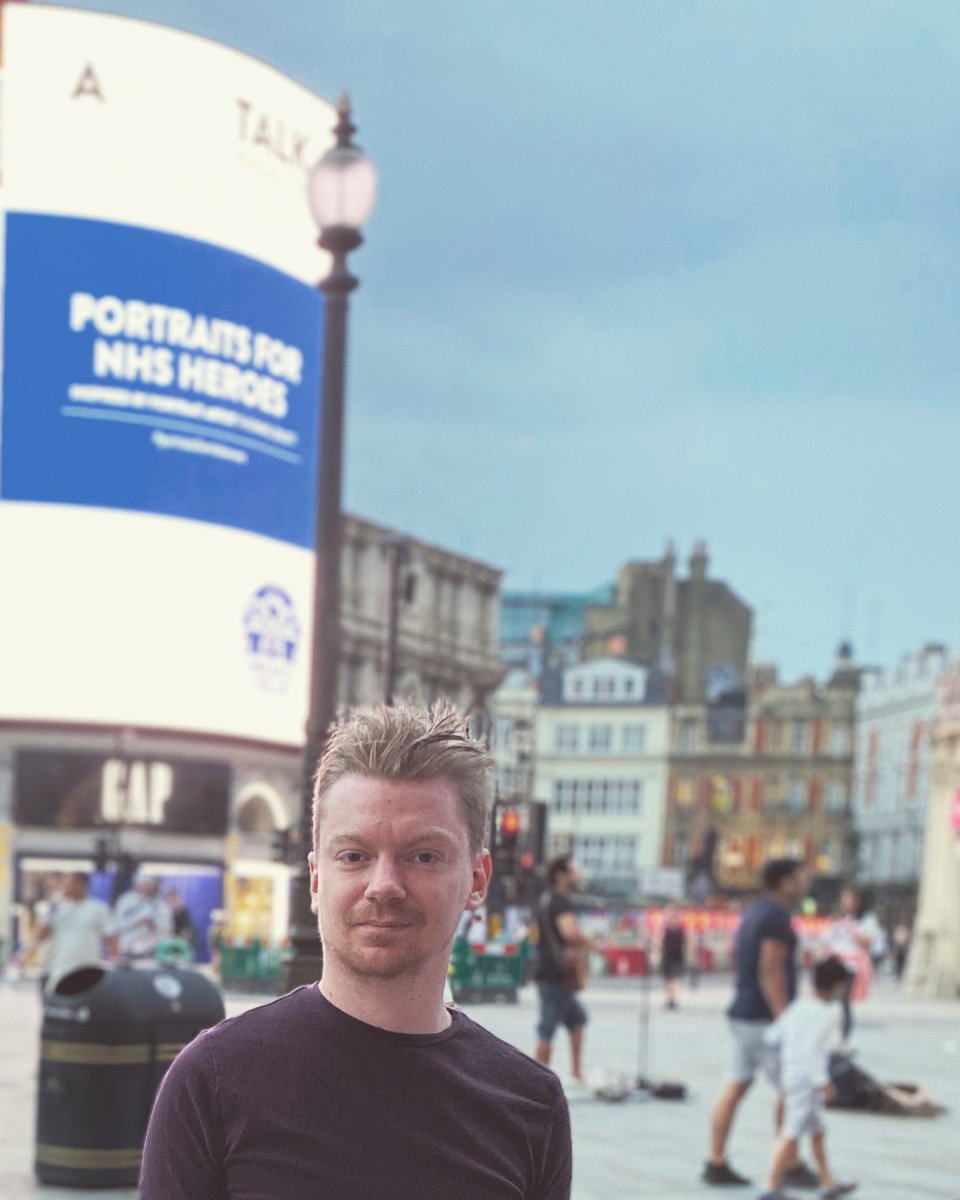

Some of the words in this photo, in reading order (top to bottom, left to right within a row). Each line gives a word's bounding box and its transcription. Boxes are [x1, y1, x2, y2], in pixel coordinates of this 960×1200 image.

[69, 291, 252, 364] PORTRAITS
[253, 332, 303, 385] FOR
[93, 338, 174, 387] NHS
[178, 352, 289, 419] HEROES
[101, 758, 173, 825] GAP
